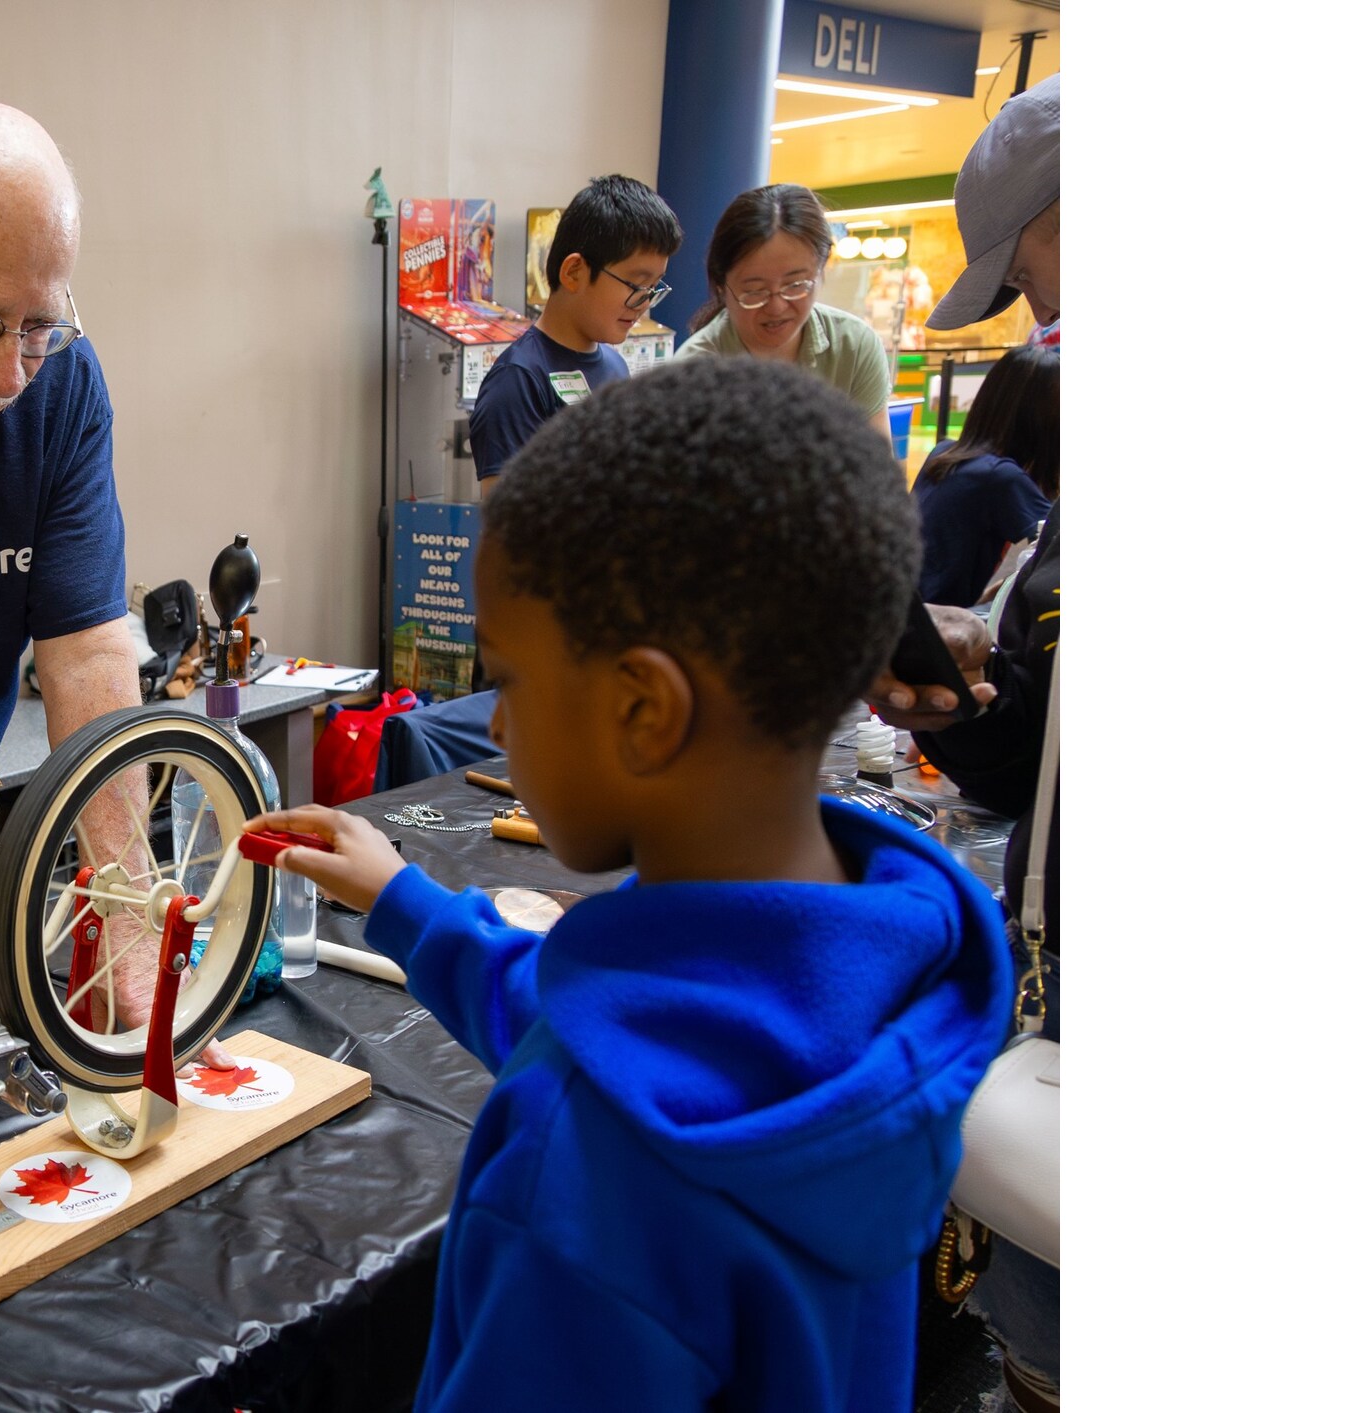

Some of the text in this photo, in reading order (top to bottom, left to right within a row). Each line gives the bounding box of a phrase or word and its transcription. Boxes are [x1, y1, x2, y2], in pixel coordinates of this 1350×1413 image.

[814, 13, 881, 76] DELI
[403, 235, 445, 260] COLLECTIBLE
[405, 246, 447, 274] PENNIES
[412, 532, 470, 549] LOOK FOR
[420, 549, 461, 562] ALL OF
[428, 565, 452, 577] OUR
[420, 579, 460, 592] NEATO
[415, 593, 465, 608] DESIGNS
[428, 625, 451, 636] THE
[415, 637, 467, 654] MUSEUM!
[226, 1090, 280, 1102] Sycamore
[60, 1191, 118, 1211] Sycamore
